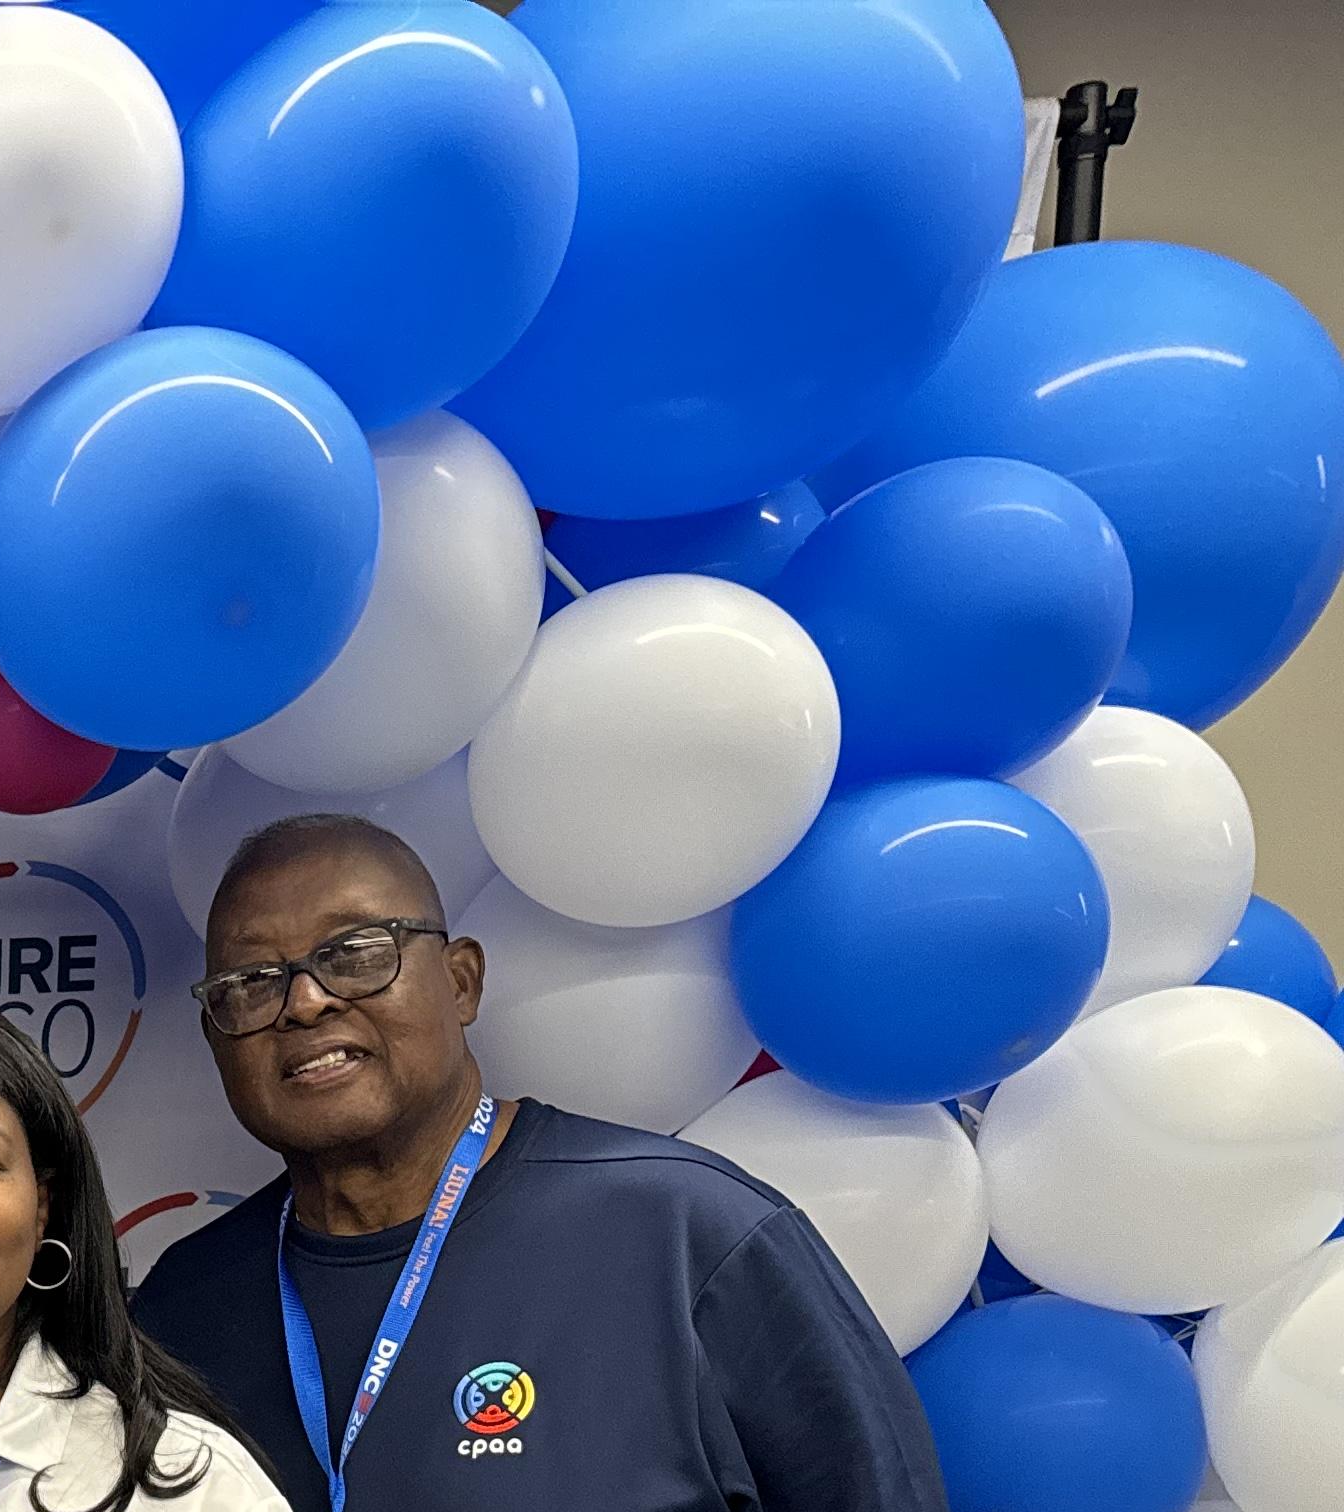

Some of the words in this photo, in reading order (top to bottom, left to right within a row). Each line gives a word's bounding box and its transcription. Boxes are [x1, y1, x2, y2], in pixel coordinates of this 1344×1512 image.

[400, 1273, 420, 1309] Power
[364, 1338, 399, 1395] DNC
[457, 1438, 523, 1459] cpaa
